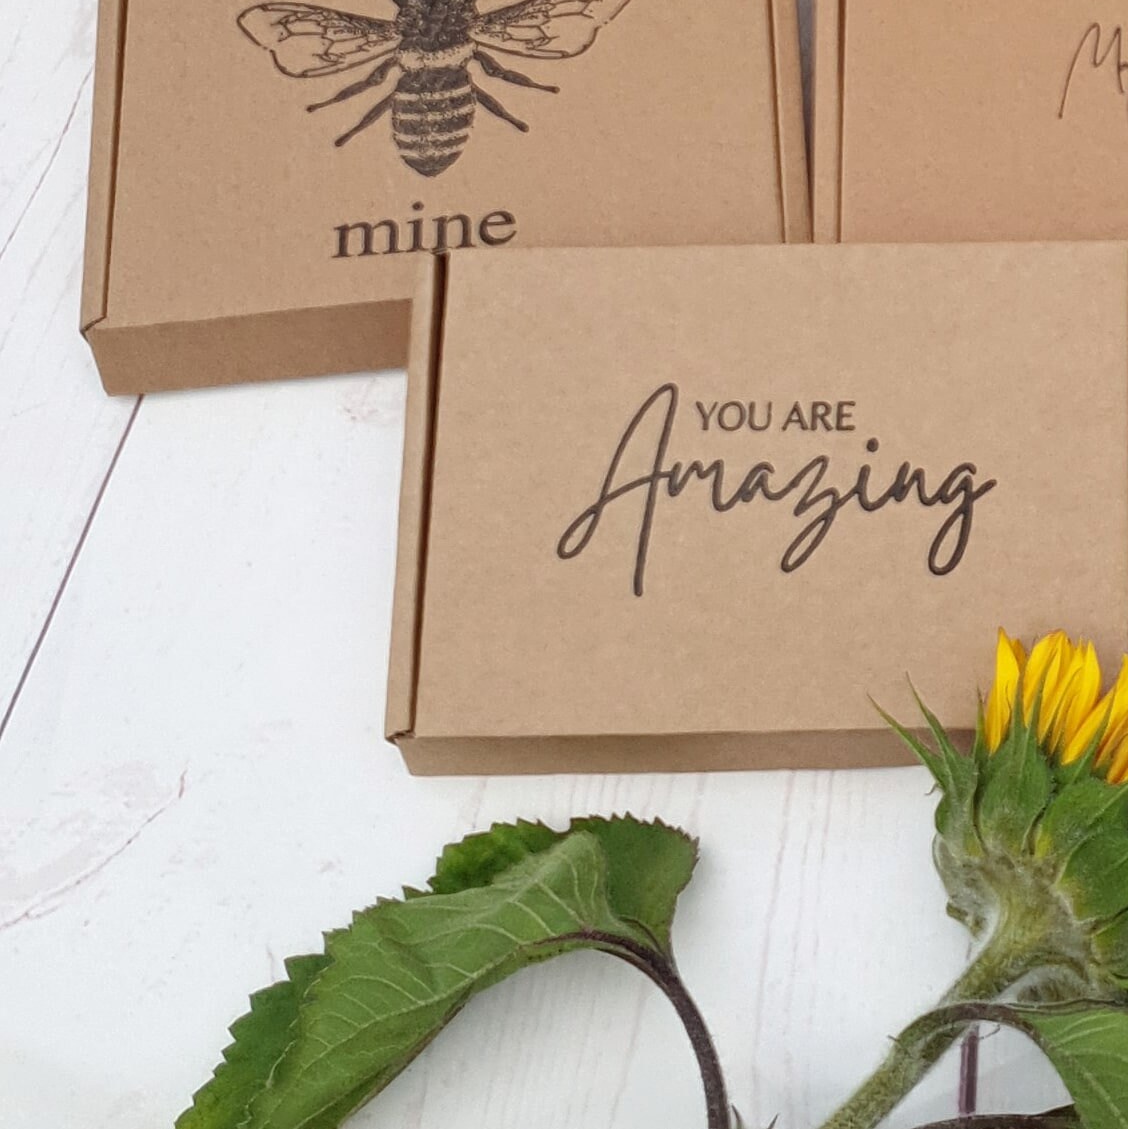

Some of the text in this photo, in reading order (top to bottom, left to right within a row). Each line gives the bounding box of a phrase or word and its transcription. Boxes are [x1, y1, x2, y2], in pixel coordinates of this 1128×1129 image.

[331, 200, 518, 259] mine
[695, 400, 857, 432] YOU ARE
[556, 382, 998, 598] Amazing
